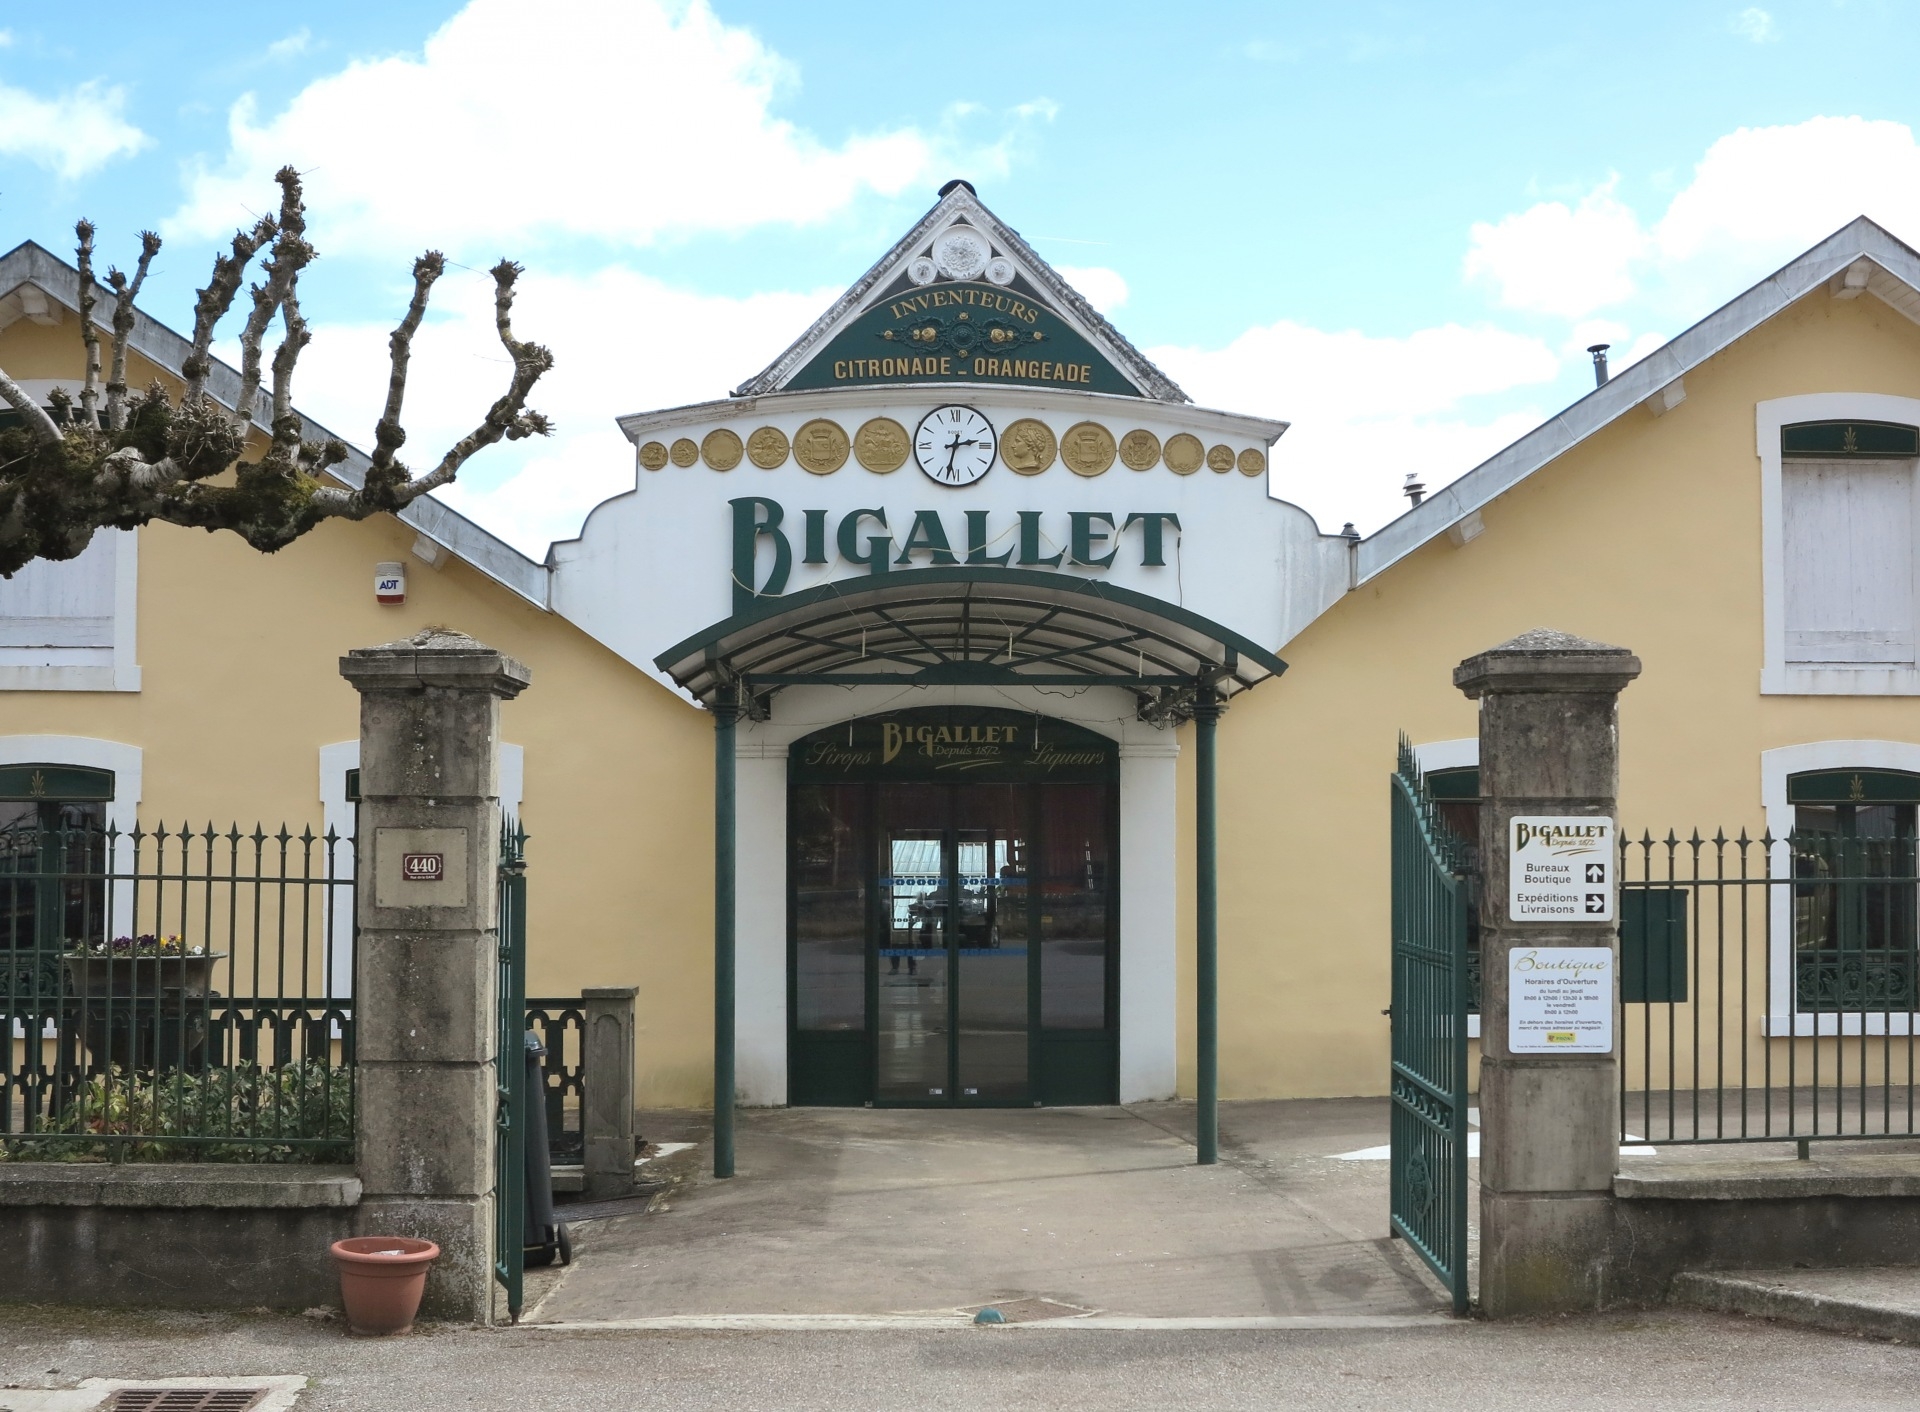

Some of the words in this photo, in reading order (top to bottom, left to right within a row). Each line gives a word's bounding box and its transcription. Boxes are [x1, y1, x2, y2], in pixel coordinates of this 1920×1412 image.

[890, 290, 1038, 324] INVENTEURS
[834, 357, 951, 379] CITRONADE
[974, 357, 1091, 383] ORANGEADE
[728, 496, 1182, 614] BIGALLET
[379, 580, 399, 590] ADT
[805, 741, 872, 772] Sirops
[882, 722, 1019, 765] BIGALLET
[918, 744, 972, 758] Depuis
[974, 745, 1001, 756] 1872
[1023, 741, 1105, 772] Liqueurs
[1516, 823, 1607, 852] BIGALLET
[410, 858, 436, 873] 440
[1526, 863, 1570, 873] Bureaux
[1524, 875, 1572, 885] Boutique
[1517, 893, 1579, 904] Expéditions
[1520, 905, 1575, 914] Livraisons
[1514, 950, 1608, 978] Boutique
